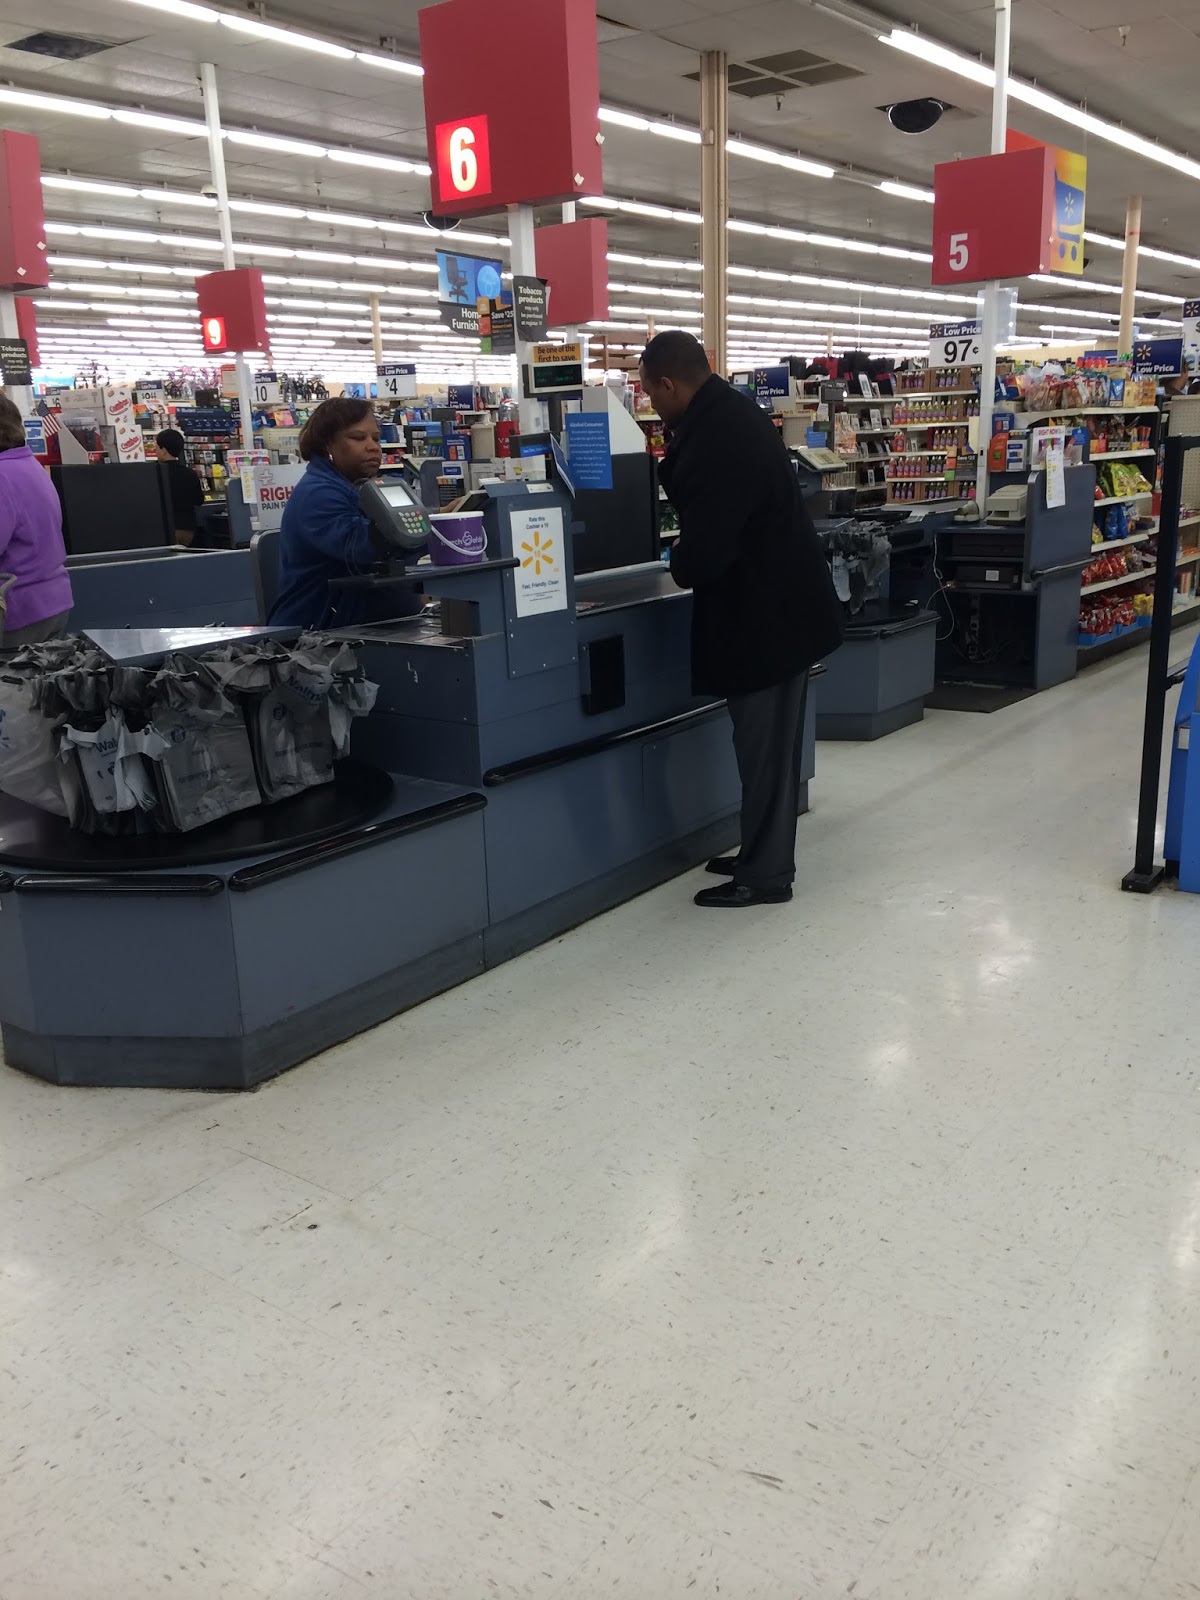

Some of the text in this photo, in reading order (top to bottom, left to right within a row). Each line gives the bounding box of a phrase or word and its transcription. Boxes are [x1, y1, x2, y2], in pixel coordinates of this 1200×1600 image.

[449, 126, 478, 192] 6
[948, 233, 970, 271] 5
[518, 286, 542, 295] Tobacco
[518, 296, 544, 304] products
[491, 311, 504, 319] Save
[452, 318, 479, 331] Furnish
[208, 318, 221, 345] 9
[943, 326, 982, 336] Low Price
[546, 346, 558, 354] one
[565, 344, 576, 352] the
[538, 355, 552, 363] first
[1154, 363, 1175, 372] Price
[385, 378, 398, 395] $4
[260, 486, 294, 501] RIGH
[261, 502, 280, 510] PAIN
